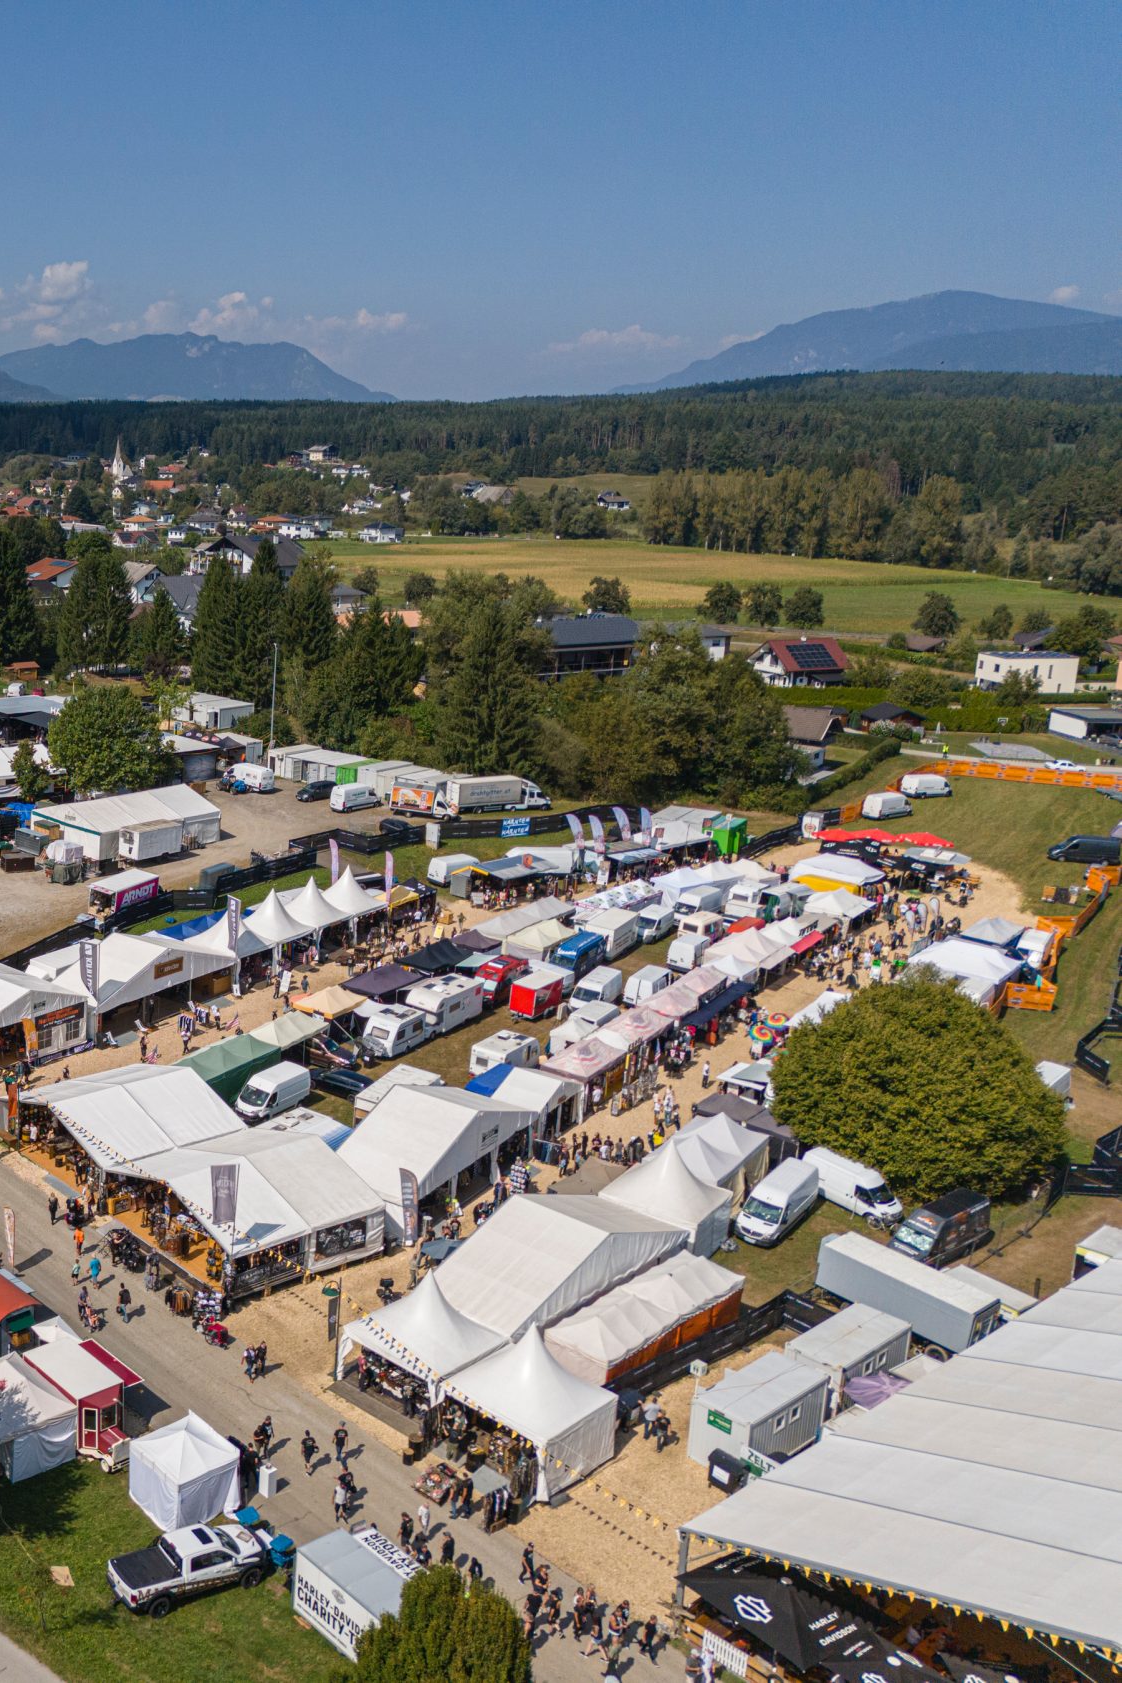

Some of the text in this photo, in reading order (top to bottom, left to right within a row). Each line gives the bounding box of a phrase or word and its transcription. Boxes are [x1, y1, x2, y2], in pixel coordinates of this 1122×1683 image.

[121, 882, 156, 904] ARNDT
[809, 1612, 839, 1631] HARLEY
[819, 1624, 857, 1647] DAVIDSON
